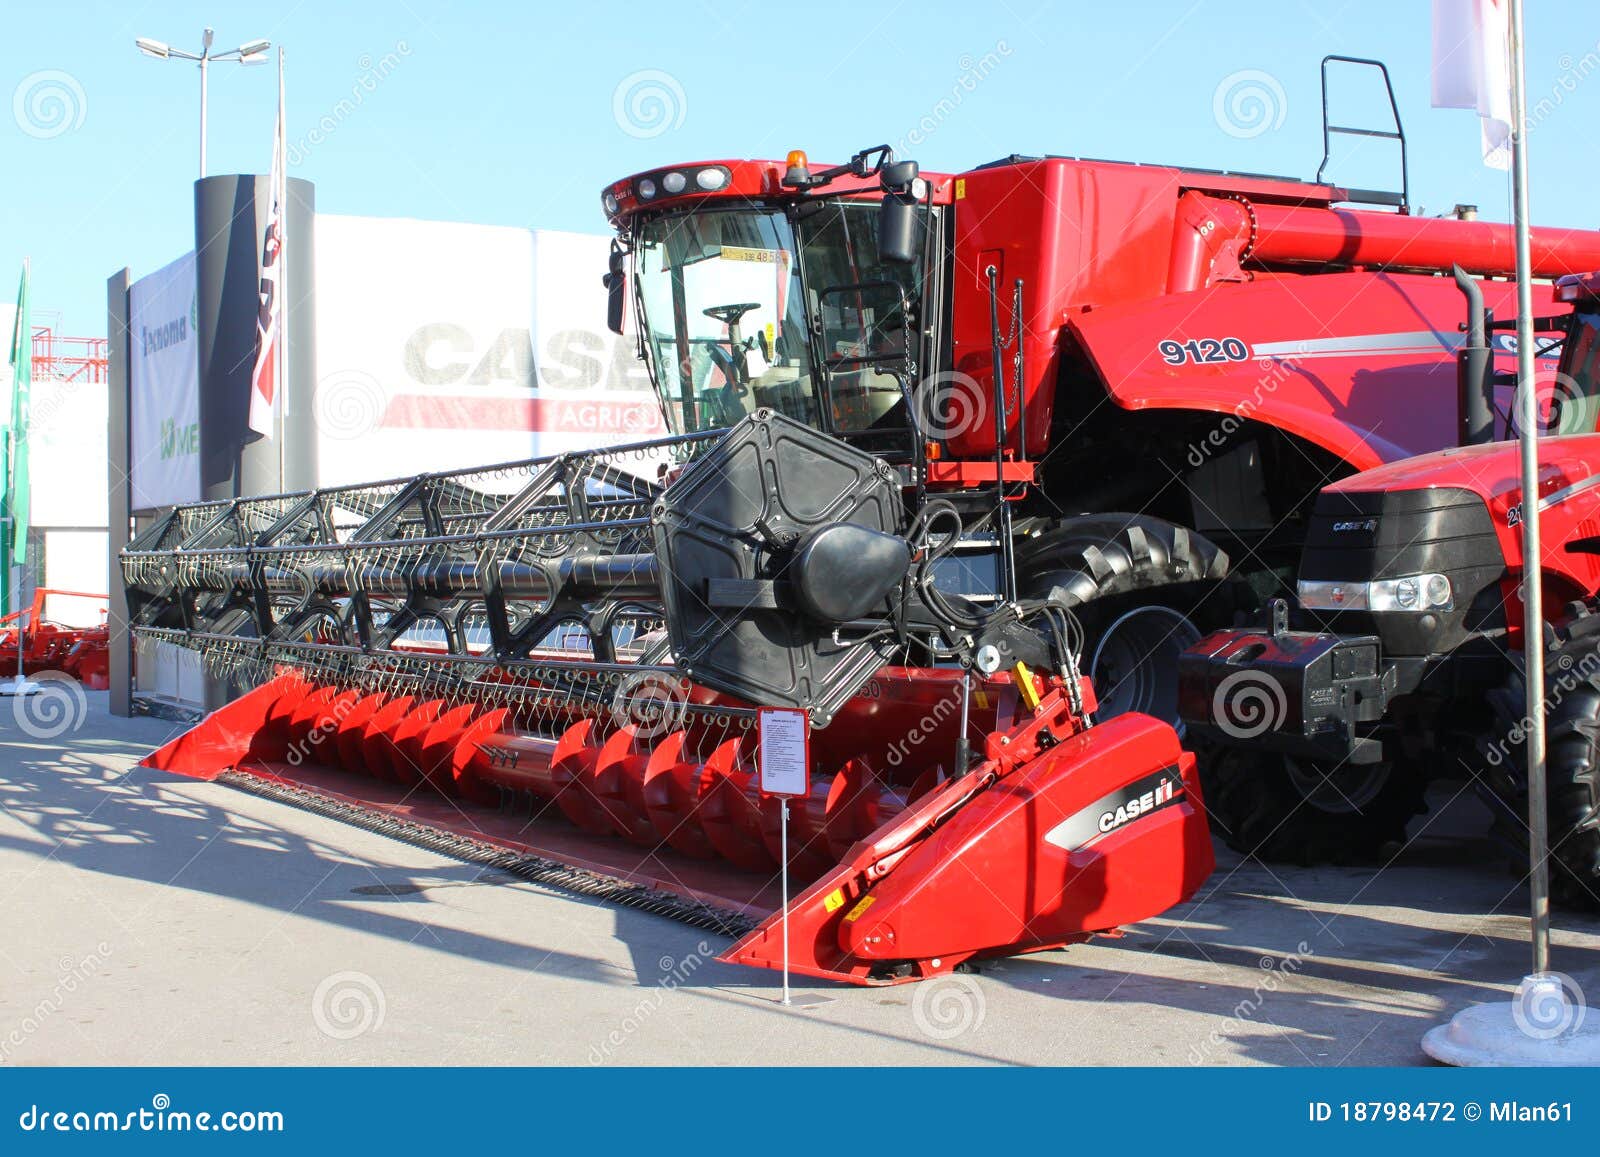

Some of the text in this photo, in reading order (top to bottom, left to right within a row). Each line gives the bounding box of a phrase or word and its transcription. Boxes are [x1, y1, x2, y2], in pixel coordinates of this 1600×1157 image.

[403, 323, 672, 392] CASE
[1158, 336, 1249, 366] 9120
[559, 405, 660, 430] AGRICU
[1333, 522, 1363, 531] CASE
[1506, 502, 1522, 528] 21
[1099, 791, 1154, 832] CASE
